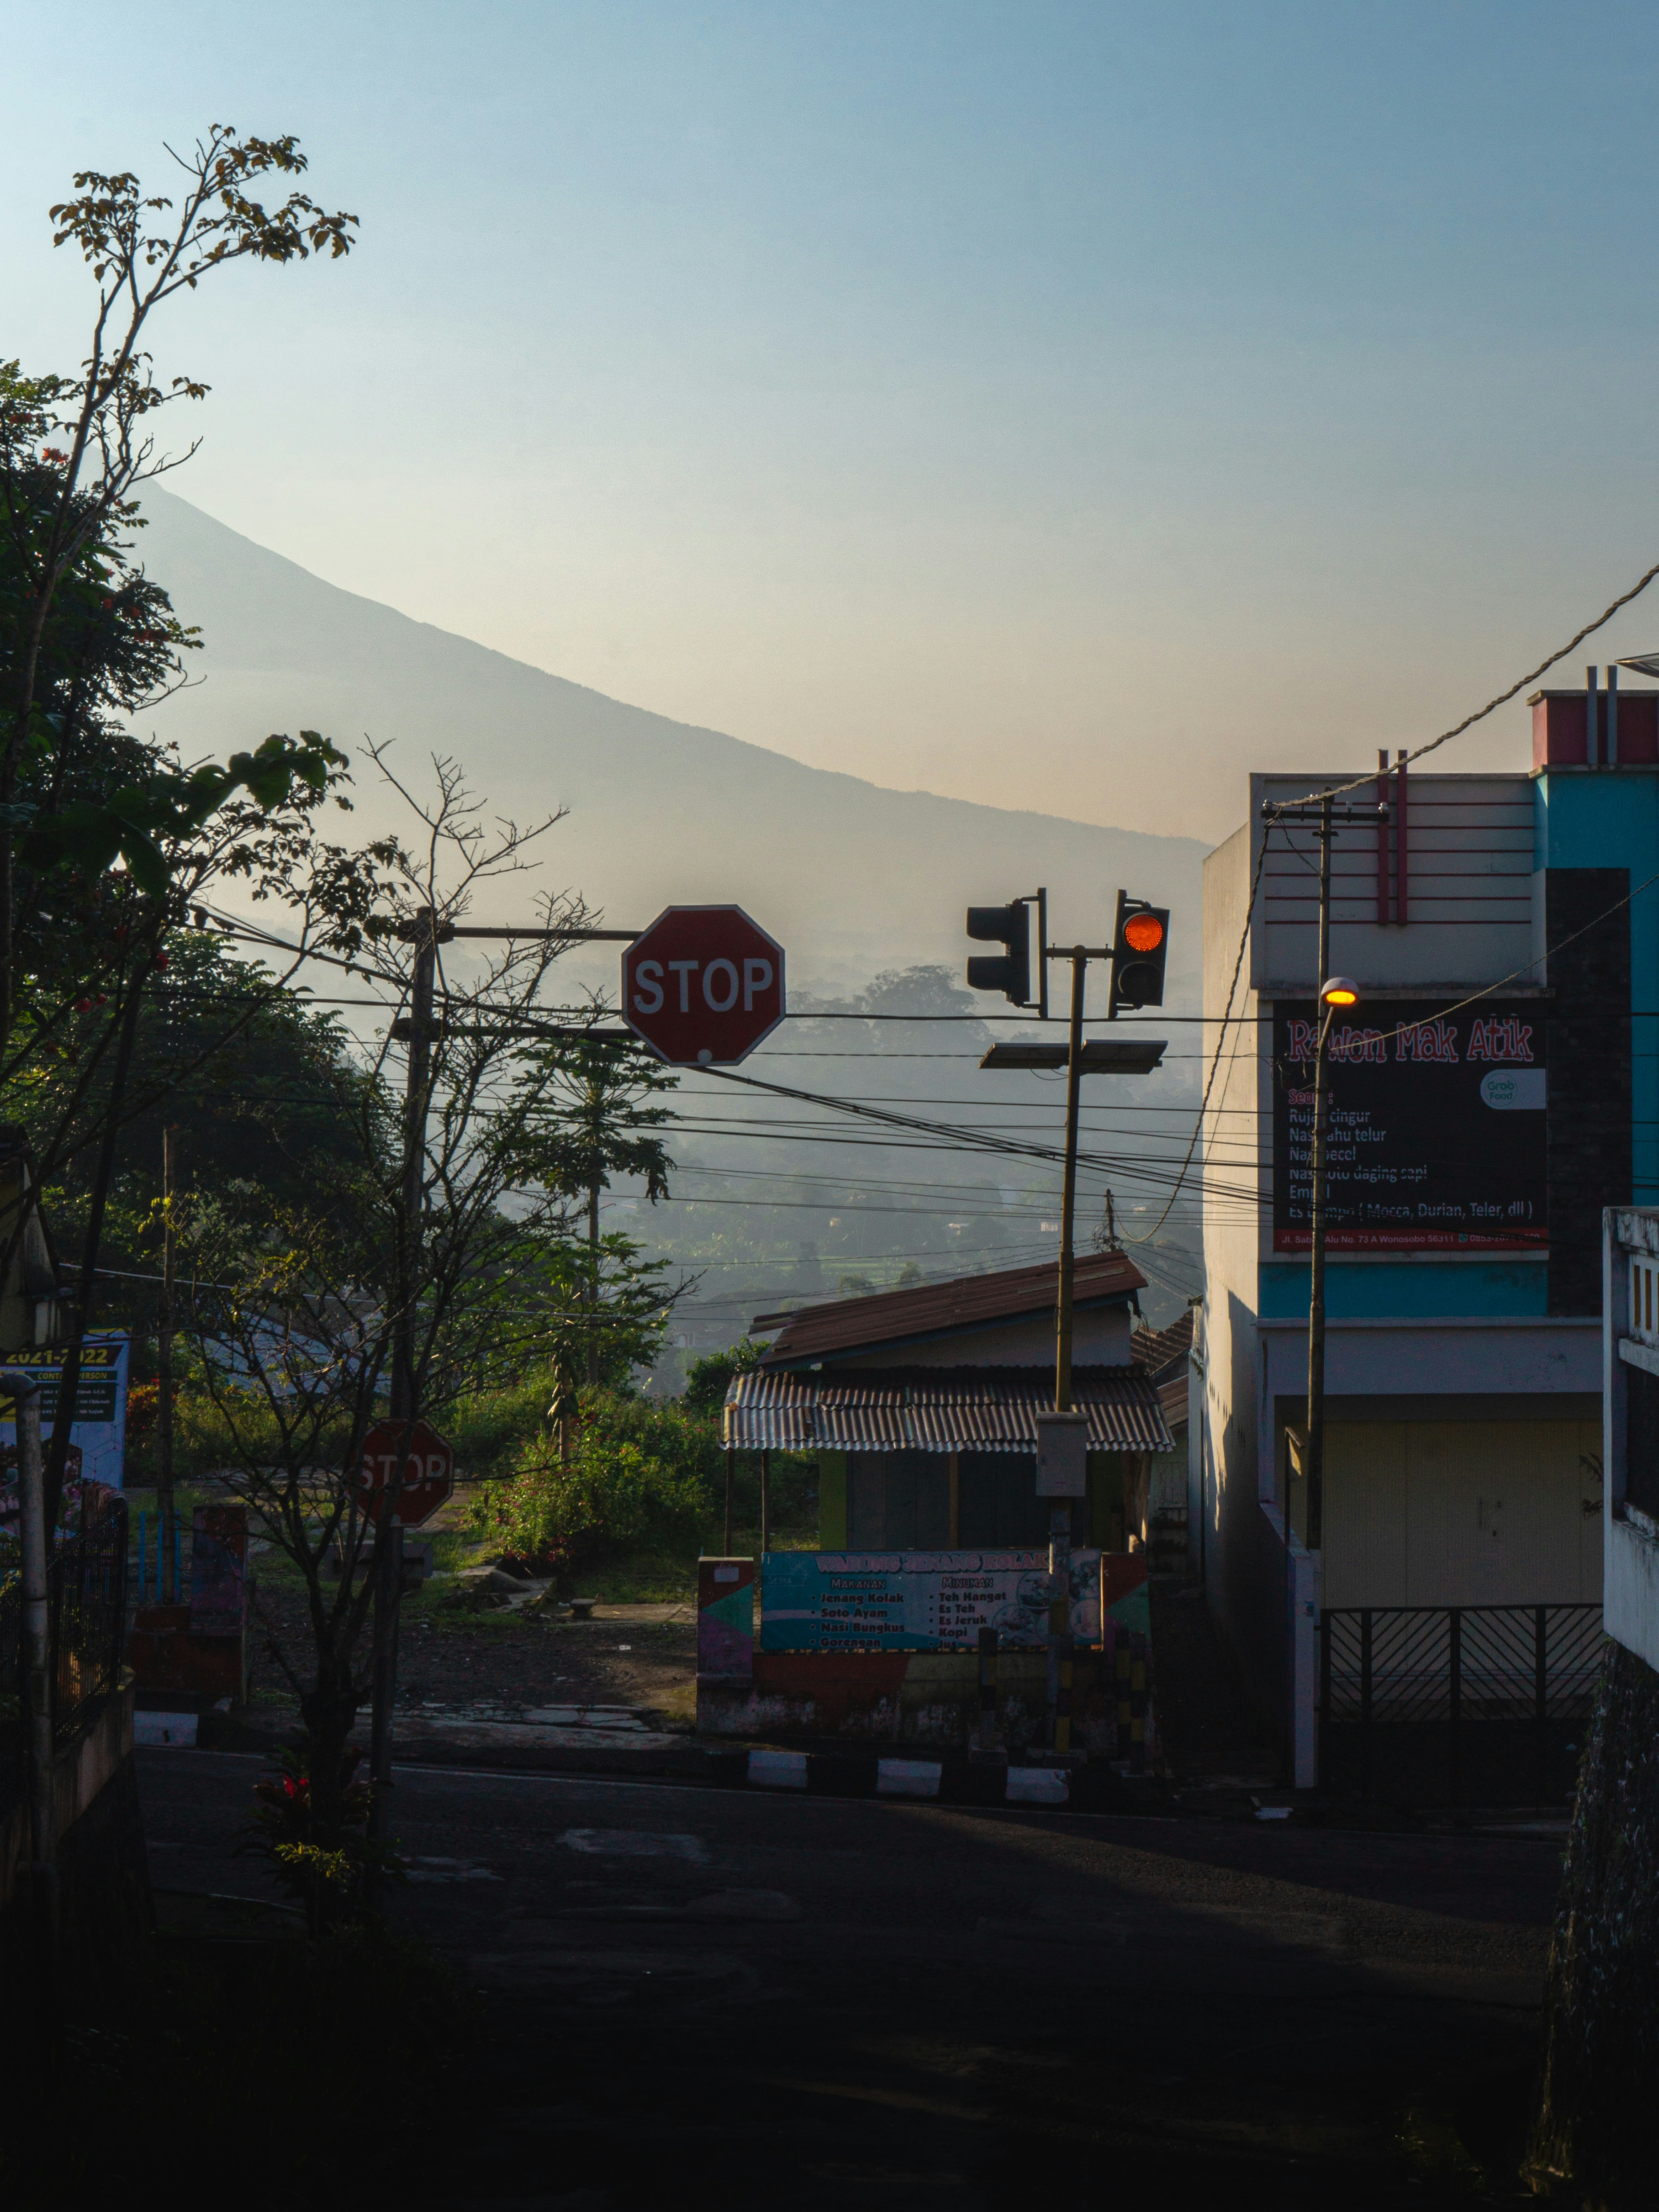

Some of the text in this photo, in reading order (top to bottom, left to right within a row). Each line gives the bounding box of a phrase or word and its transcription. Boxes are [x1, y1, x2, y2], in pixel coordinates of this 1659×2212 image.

[634, 958, 773, 1014] STOP
[1395, 1019, 1458, 1063] Mak
[1466, 1013, 1534, 1062] Atik
[1487, 1080, 1515, 1091] Grab
[1289, 1108, 1370, 1126] Ruja cingur
[1289, 1126, 1386, 1142] Nas ahu telur
[1289, 1146, 1356, 1161] Nas ecel
[1289, 1164, 1427, 1183] Nas oto daging sapi
[1289, 1204, 1303, 1218] Es
[1367, 1204, 1414, 1220] Mocca,
[1418, 1203, 1465, 1220] Durian,
[1469, 1202, 1504, 1219] Teler,
[1508, 1201, 1524, 1216] dll
[359, 1453, 446, 1492] STOP
[982, 1552, 1050, 1572] KOLAK
[831, 1578, 886, 1589] MAKANAN
[941, 1577, 993, 1589] MINUMAN
[821, 1593, 903, 1605] Jenang Kolak
[939, 1592, 1006, 1603] Teh Hangat
[821, 1608, 888, 1619] Soto Ayam
[939, 1604, 976, 1613] Es Teh
[939, 1615, 987, 1625] Es Jeruk
[821, 1623, 905, 1634] Nasi Bungkus
[939, 1627, 967, 1638] Kopi
[820, 1637, 881, 1648] Gorengan
[939, 1640, 956, 1648] Jus
